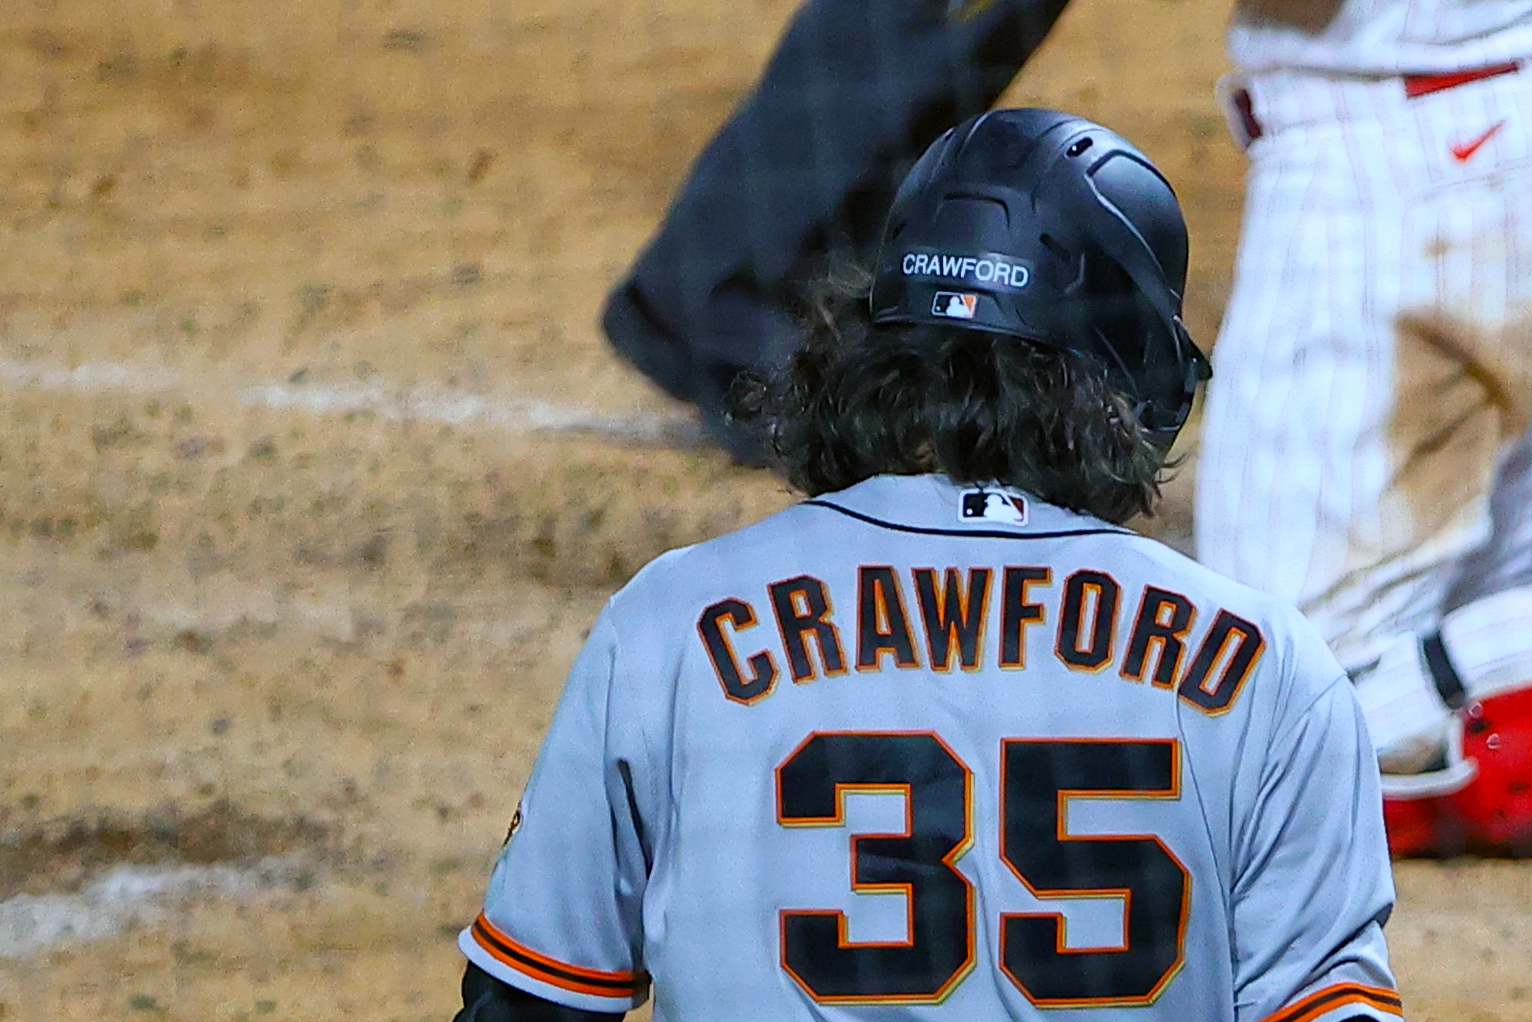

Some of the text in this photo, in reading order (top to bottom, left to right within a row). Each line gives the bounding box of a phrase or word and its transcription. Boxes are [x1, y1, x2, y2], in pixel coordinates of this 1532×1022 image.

[902, 253, 1029, 288] CRAWFORD
[697, 564, 1266, 717] CRAWFORD
[775, 731, 1192, 1008] 35
